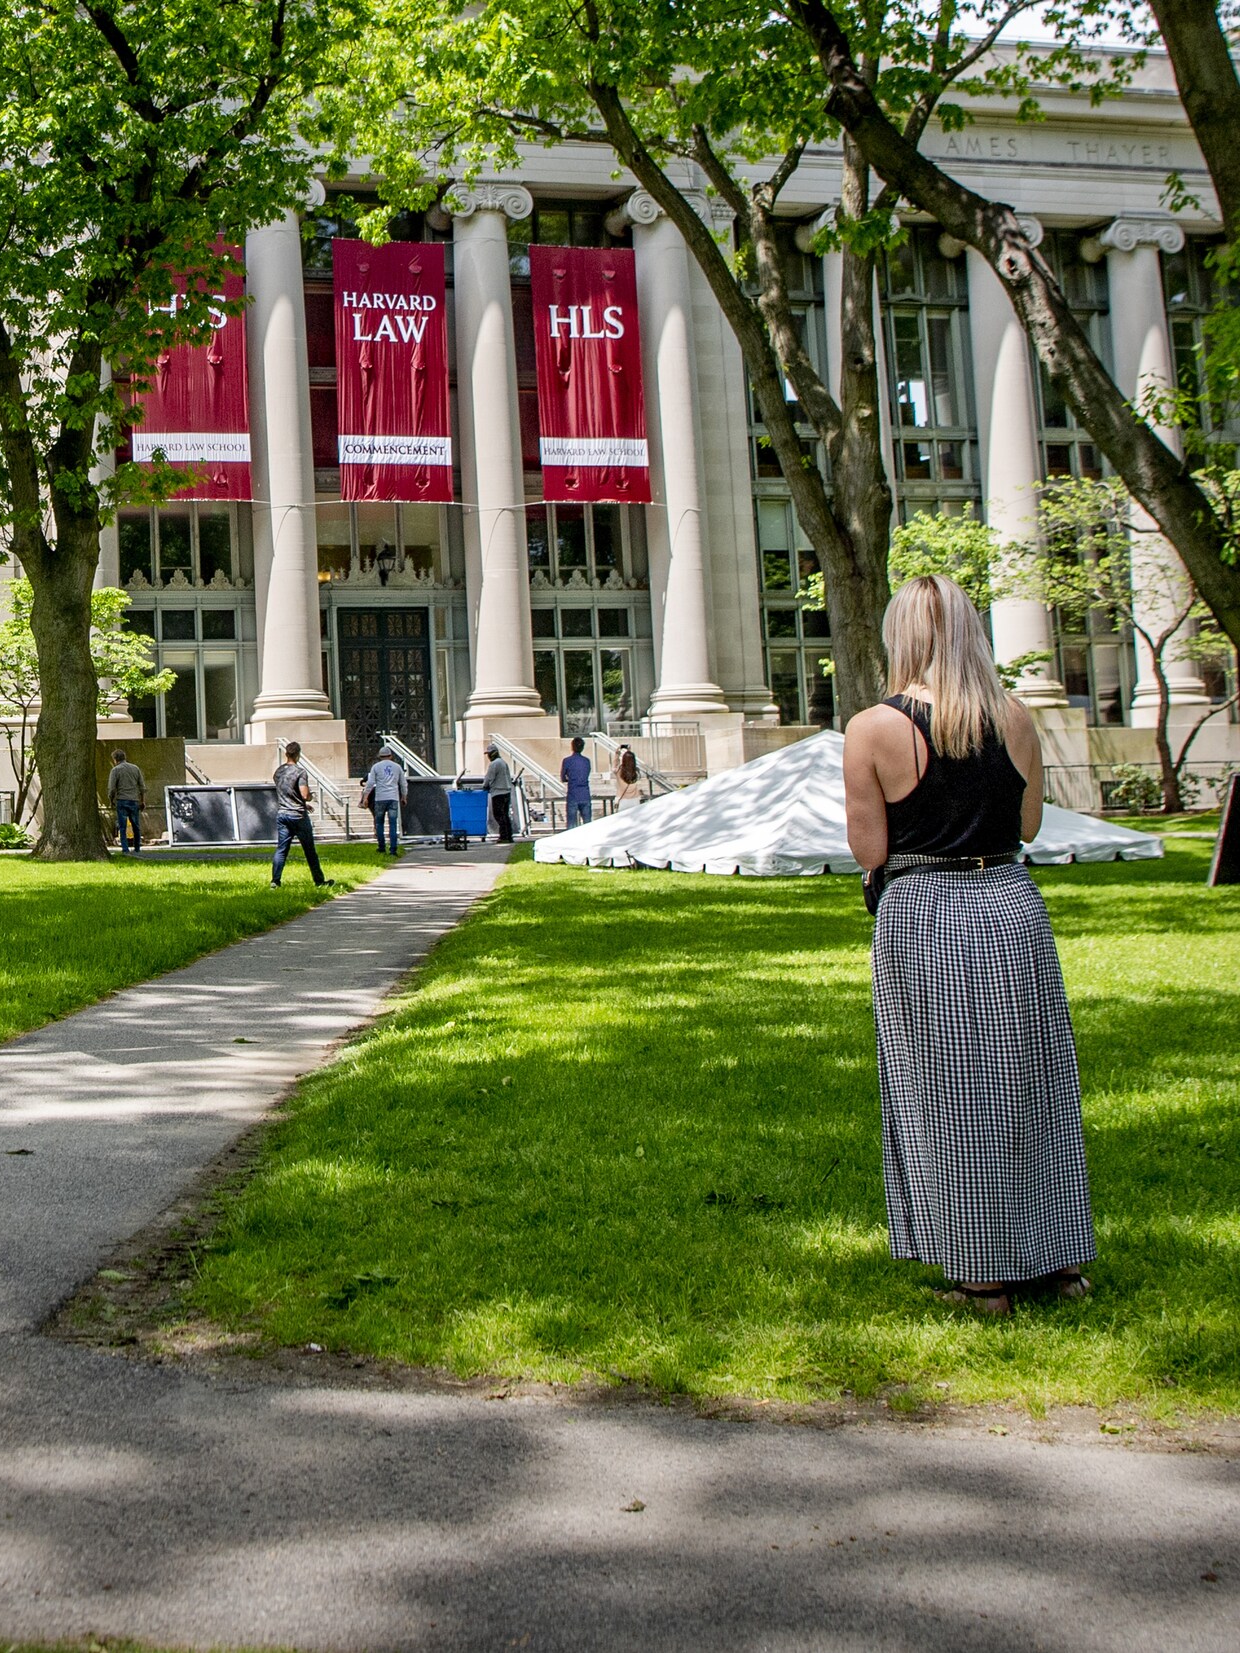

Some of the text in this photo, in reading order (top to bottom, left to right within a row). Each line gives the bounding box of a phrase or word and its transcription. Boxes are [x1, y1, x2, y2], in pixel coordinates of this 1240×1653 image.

[945, 136, 1173, 165] AMES THAYER
[342, 291, 437, 311] HARVARD
[352, 313, 429, 343] LAW
[548, 304, 625, 339] HLS
[185, 443, 205, 452] LAW
[207, 443, 247, 452] SCHOOL
[345, 444, 445, 456] COMMENCEMENT
[544, 447, 645, 457] HARVARD LAW SCHOOL
